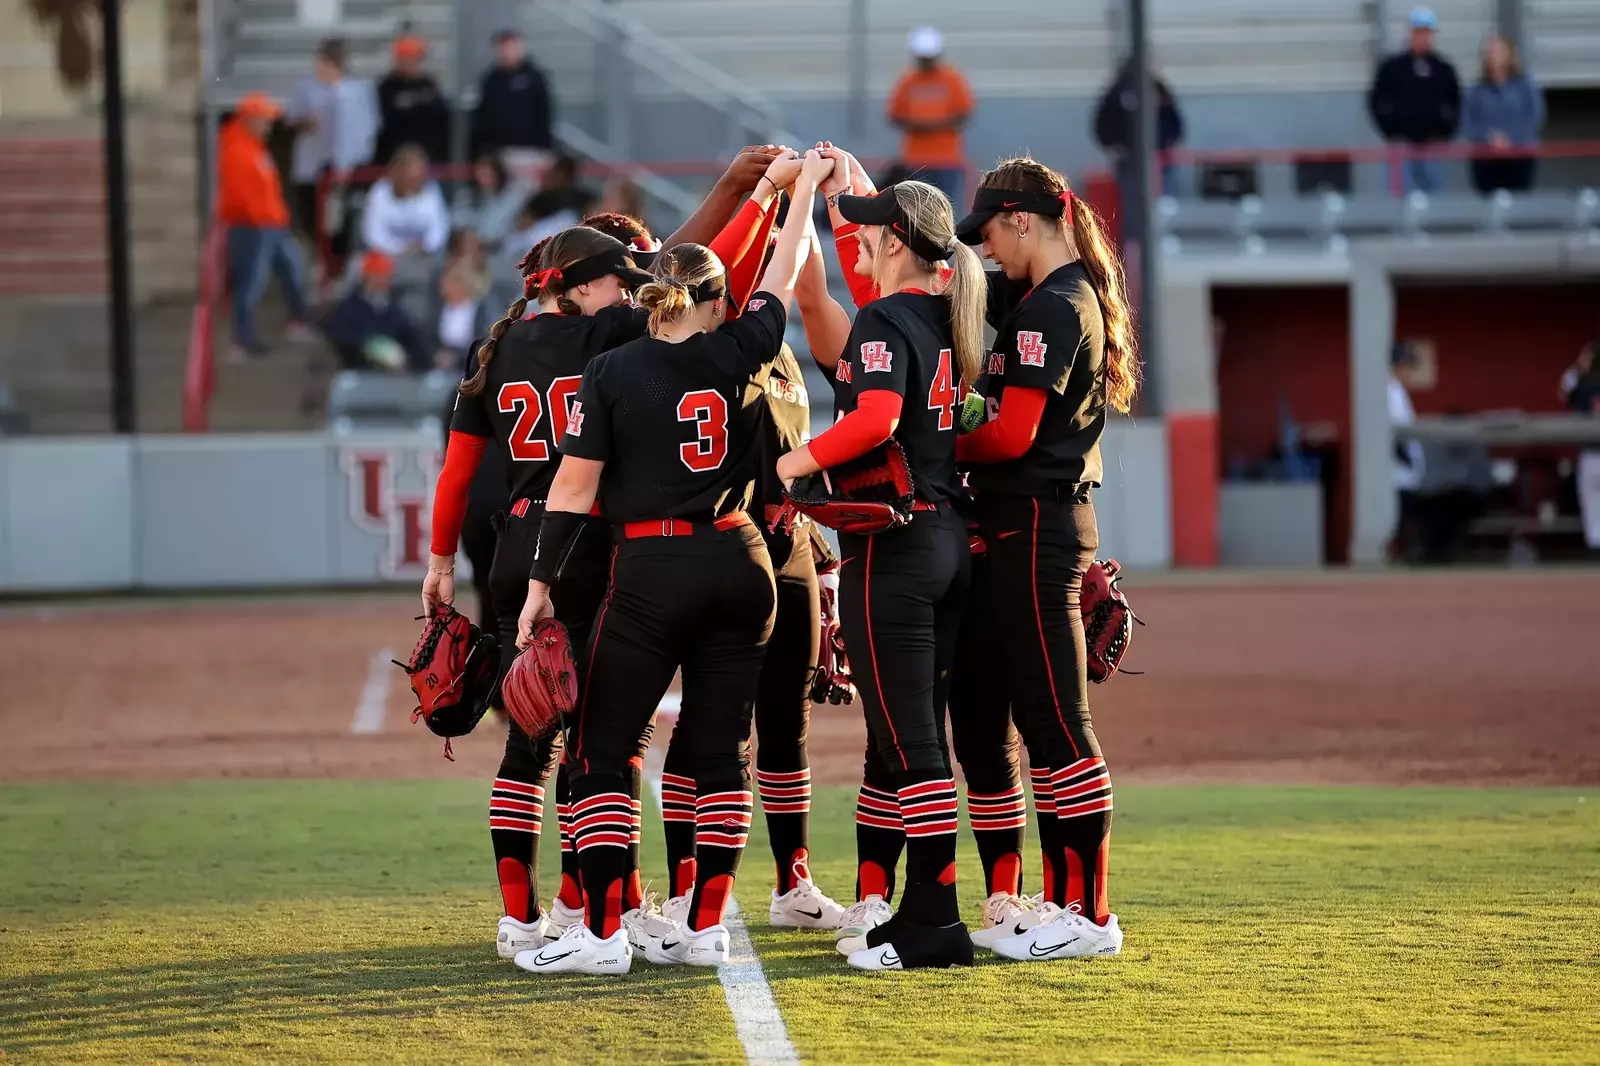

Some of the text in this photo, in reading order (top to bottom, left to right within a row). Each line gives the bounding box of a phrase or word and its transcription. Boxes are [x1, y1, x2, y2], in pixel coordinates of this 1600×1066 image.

[861, 341, 892, 373] UH
[1017, 331, 1047, 367] UH
[928, 349, 968, 431] 4
[677, 389, 728, 472] 3
[425, 672, 439, 691] 20
